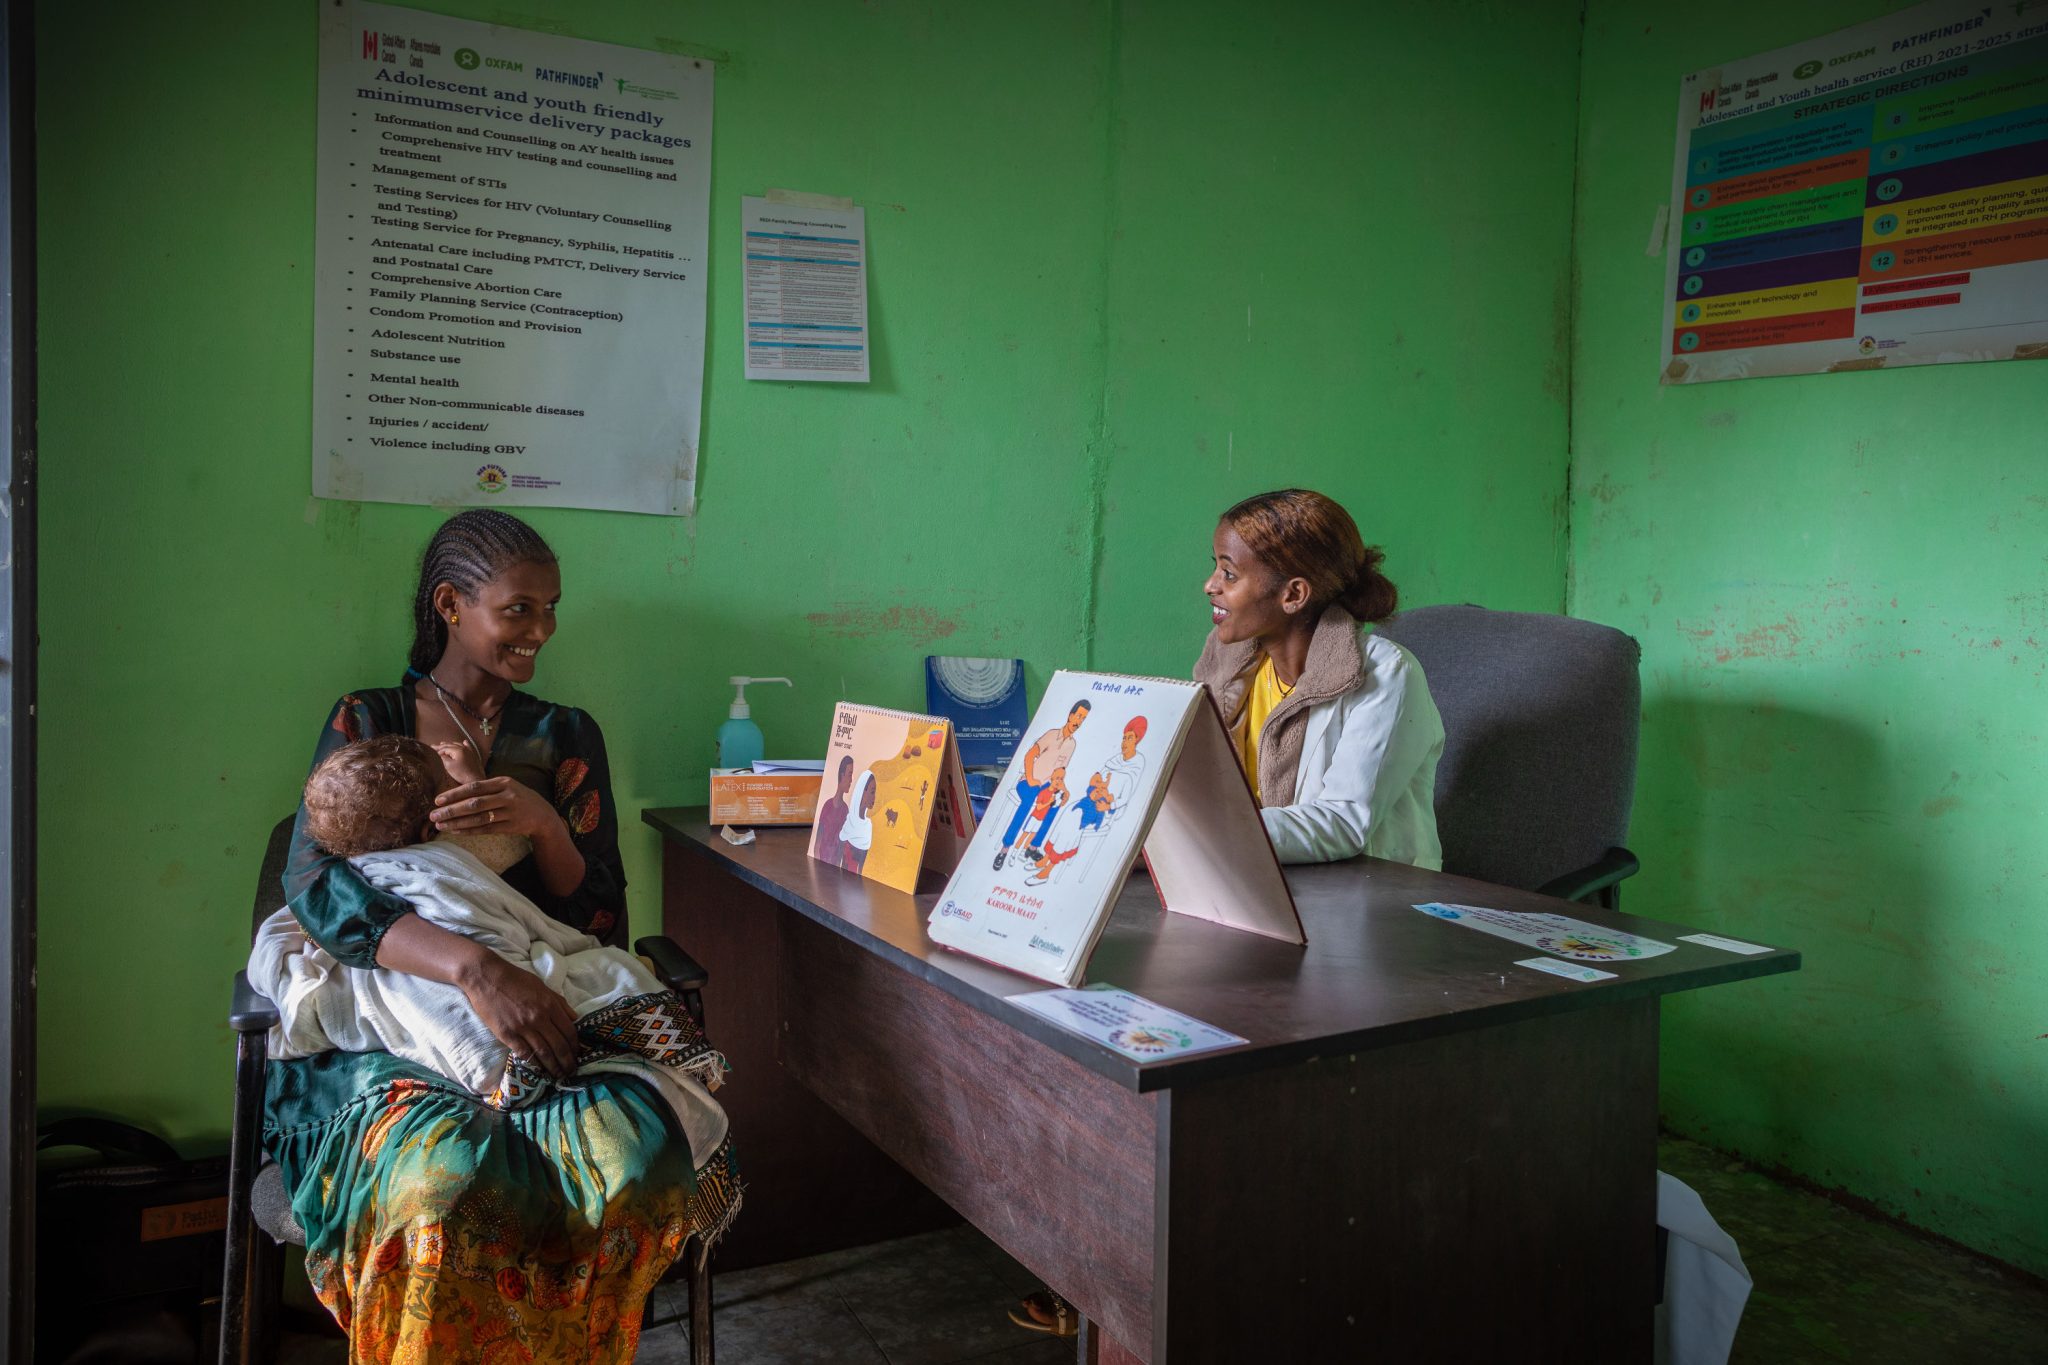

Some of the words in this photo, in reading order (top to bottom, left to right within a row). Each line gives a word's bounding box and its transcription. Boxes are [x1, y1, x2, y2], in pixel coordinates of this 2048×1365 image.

[1891, 15, 1984, 52] PATHFINDER
[485, 57, 523, 73] OXFAM
[1828, 45, 1876, 67] OXFAM
[535, 67, 599, 90] PATHFINDER
[1698, 102, 1753, 125] Adolescent
[1756, 96, 1775, 110] and
[1779, 87, 1810, 104] Youth
[1814, 76, 1849, 95] health
[1852, 64, 1896, 84] service
[1900, 52, 1933, 73] (RH)
[1936, 30, 2011, 62] 2021-2025
[374, 67, 488, 97] Adolescent
[493, 89, 528, 103] and
[533, 95, 587, 113] youth
[593, 102, 664, 128] friendly
[1793, 90, 1870, 120] STRATEGIC
[1874, 63, 1969, 99] DIRECTIONS
[374, 112, 453, 133] Information
[456, 126, 480, 136] and
[482, 129, 557, 150] Counselling
[560, 142, 577, 151] on
[578, 143, 598, 154] AY
[600, 145, 637, 160] health
[640, 152, 674, 165] issues
[529, 111, 606, 137] delivery
[610, 127, 691, 148] packages
[379, 145, 442, 163] treatment
[381, 130, 482, 153] Comprehensive
[486, 145, 514, 157] HIV
[517, 150, 557, 166] testing
[561, 158, 583, 168] and
[586, 161, 653, 179] counselling
[656, 172, 677, 181] and
[371, 162, 456, 182] Management
[460, 175, 475, 185] of
[477, 177, 507, 189] STIs
[373, 183, 422, 200] Testing
[426, 190, 479, 205] Services
[483, 197, 503, 208] for
[505, 200, 533, 211] HIV
[536, 204, 600, 222] (Voluntary
[603, 213, 672, 232] Counselling
[378, 201, 402, 212] and
[405, 203, 458, 220] Testing)
[1906, 208, 1964, 226] improvement
[1966, 205, 1984, 215] and
[1988, 198, 2020, 213] quality
[1907, 202, 1946, 216] Enhance
[1948, 196, 1979, 211] quality
[1982, 188, 2027, 206] planning,
[1905, 225, 1920, 234] are
[1922, 217, 1967, 233] integrated
[1970, 215, 1979, 223] in
[1981, 211, 1997, 222] RH
[371, 214, 419, 231] Testing
[423, 220, 471, 235] Service
[475, 226, 493, 238] for
[497, 229, 564, 247] Pregnancy,
[568, 238, 619, 254] Syphilis,
[622, 245, 674, 259] Hepatitis
[370, 237, 434, 252] Antenatal
[438, 244, 468, 256] Care
[472, 247, 530, 265] including
[534, 255, 585, 271] PMTCT,
[589, 261, 640, 277] Delivery
[643, 268, 686, 280] Service
[372, 255, 397, 265] and
[400, 256, 460, 271] Postnatal
[463, 263, 493, 275] Care
[1917, 255, 1932, 263] RH
[371, 271, 472, 289] Comprehensive
[474, 281, 530, 295] Abortion
[534, 287, 562, 299] Care
[369, 287, 416, 302] Family
[420, 292, 477, 308] Planning
[480, 298, 526, 311] Service
[530, 303, 623, 322] (Contraception)
[369, 306, 425, 319] Condom
[428, 311, 495, 327] Promotion
[498, 319, 521, 328] and
[524, 320, 582, 334] Provision
[371, 328, 444, 343] Adolescent
[447, 334, 505, 348] Nutrition
[370, 348, 436, 362] Substance
[439, 355, 461, 364] use
[370, 372, 416, 385] Mental
[420, 375, 460, 388] health
[368, 393, 406, 404] Other
[409, 396, 532, 413] Non-communicable
[535, 404, 584, 416] diseases
[369, 415, 419, 427] Injuries
[423, 418, 428, 428] /
[431, 420, 489, 431] accident/
[369, 437, 427, 449] Violence
[431, 440, 491, 455] including
[494, 444, 526, 454] GBV
[715, 783, 742, 792] LATEX
[953, 907, 973, 920] USAID
[986, 897, 1016, 914] KAROORA
[1016, 907, 1037, 920] MAATI
